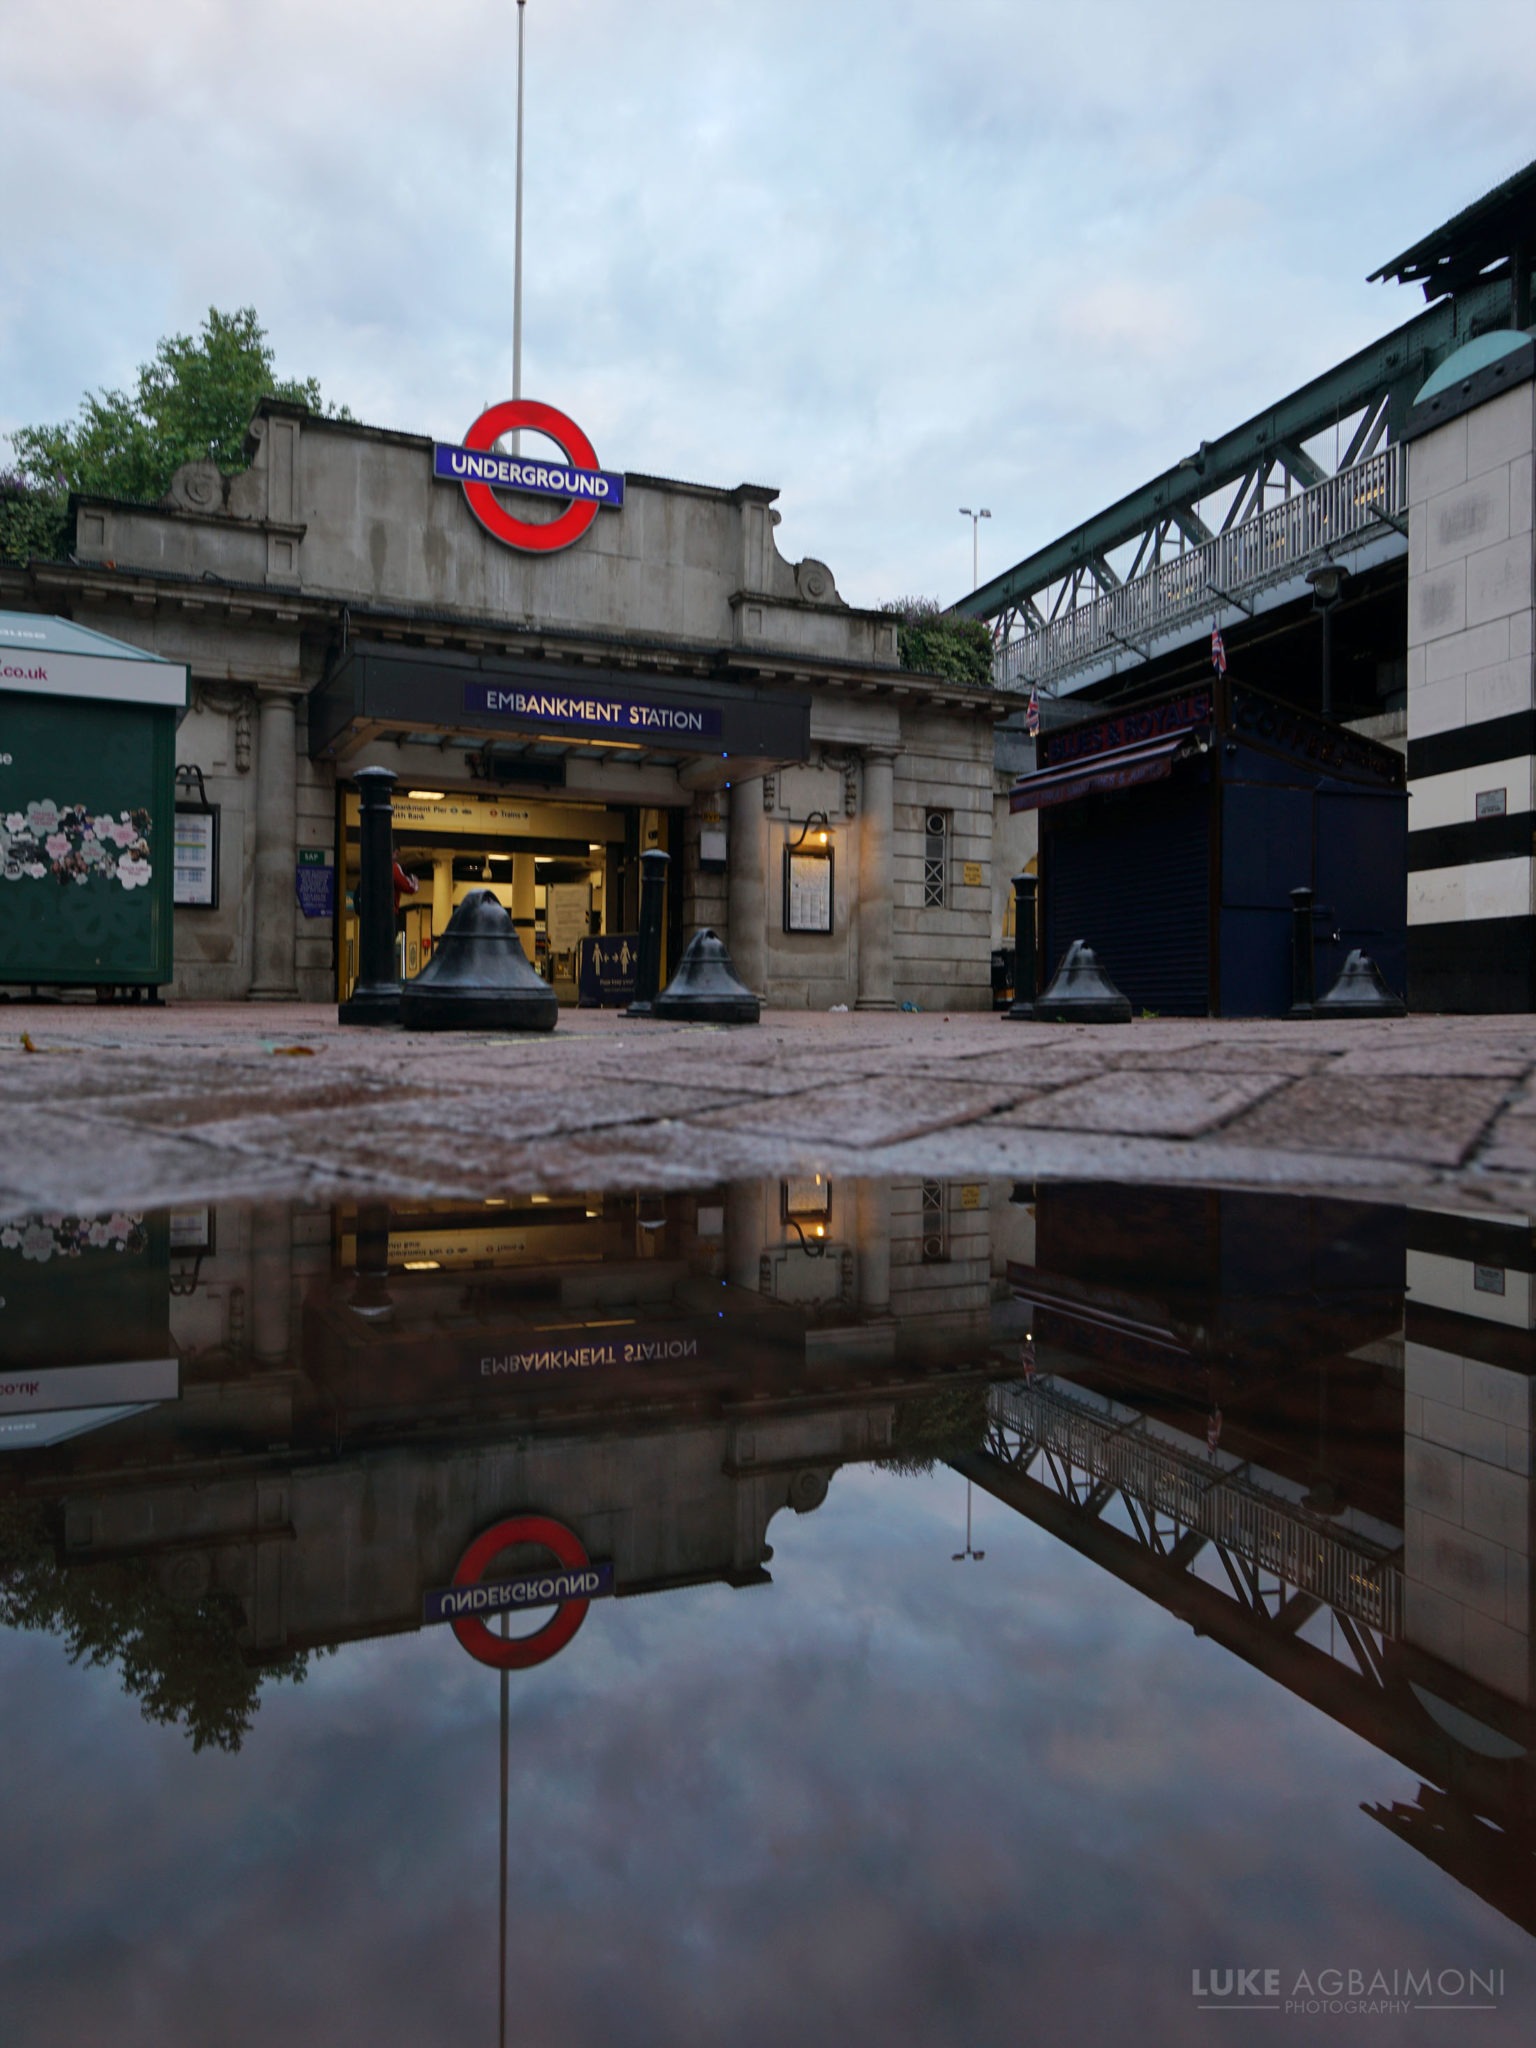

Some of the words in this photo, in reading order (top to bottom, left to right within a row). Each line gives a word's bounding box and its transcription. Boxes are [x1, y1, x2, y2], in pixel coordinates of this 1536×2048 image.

[452, 452, 609, 497] UNDERGROUND
[486, 690, 622, 722] EMBANKMENT
[629, 705, 702, 731] STATION
[1050, 730, 1102, 759] BLUES
[1108, 722, 1120, 746] &
[1124, 695, 1209, 740] ROYALS
[408, 812, 425, 820] Bank
[501, 810, 521, 819] Trains
